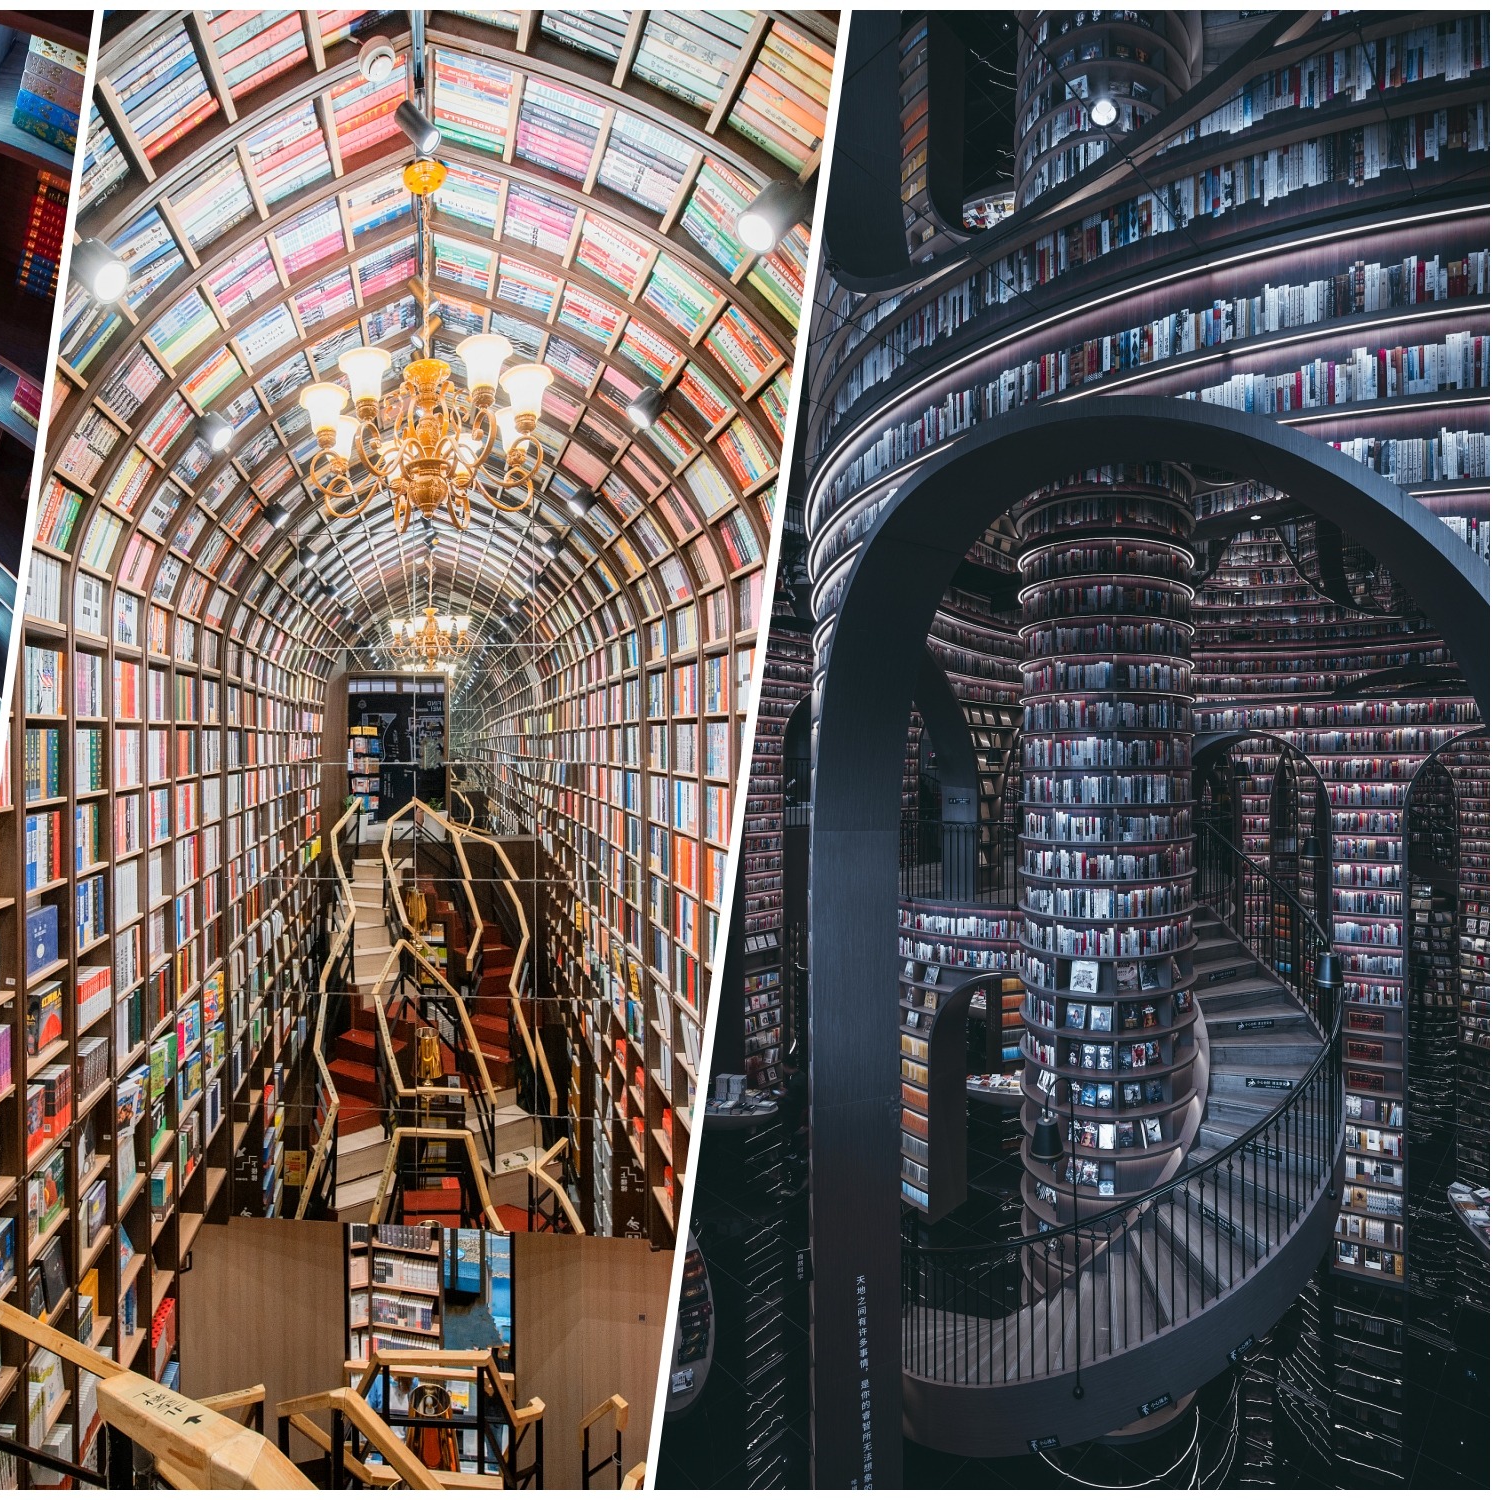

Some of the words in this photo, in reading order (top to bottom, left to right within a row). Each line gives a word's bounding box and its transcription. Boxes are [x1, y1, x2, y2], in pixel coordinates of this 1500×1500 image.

[443, 112, 501, 133] CINDERELLA
[593, 219, 641, 253] CINDERELLA
[40, 487, 58, 536] CINDERELLA
[856, 1275, 869, 1372] 天地之间有许多事情，
